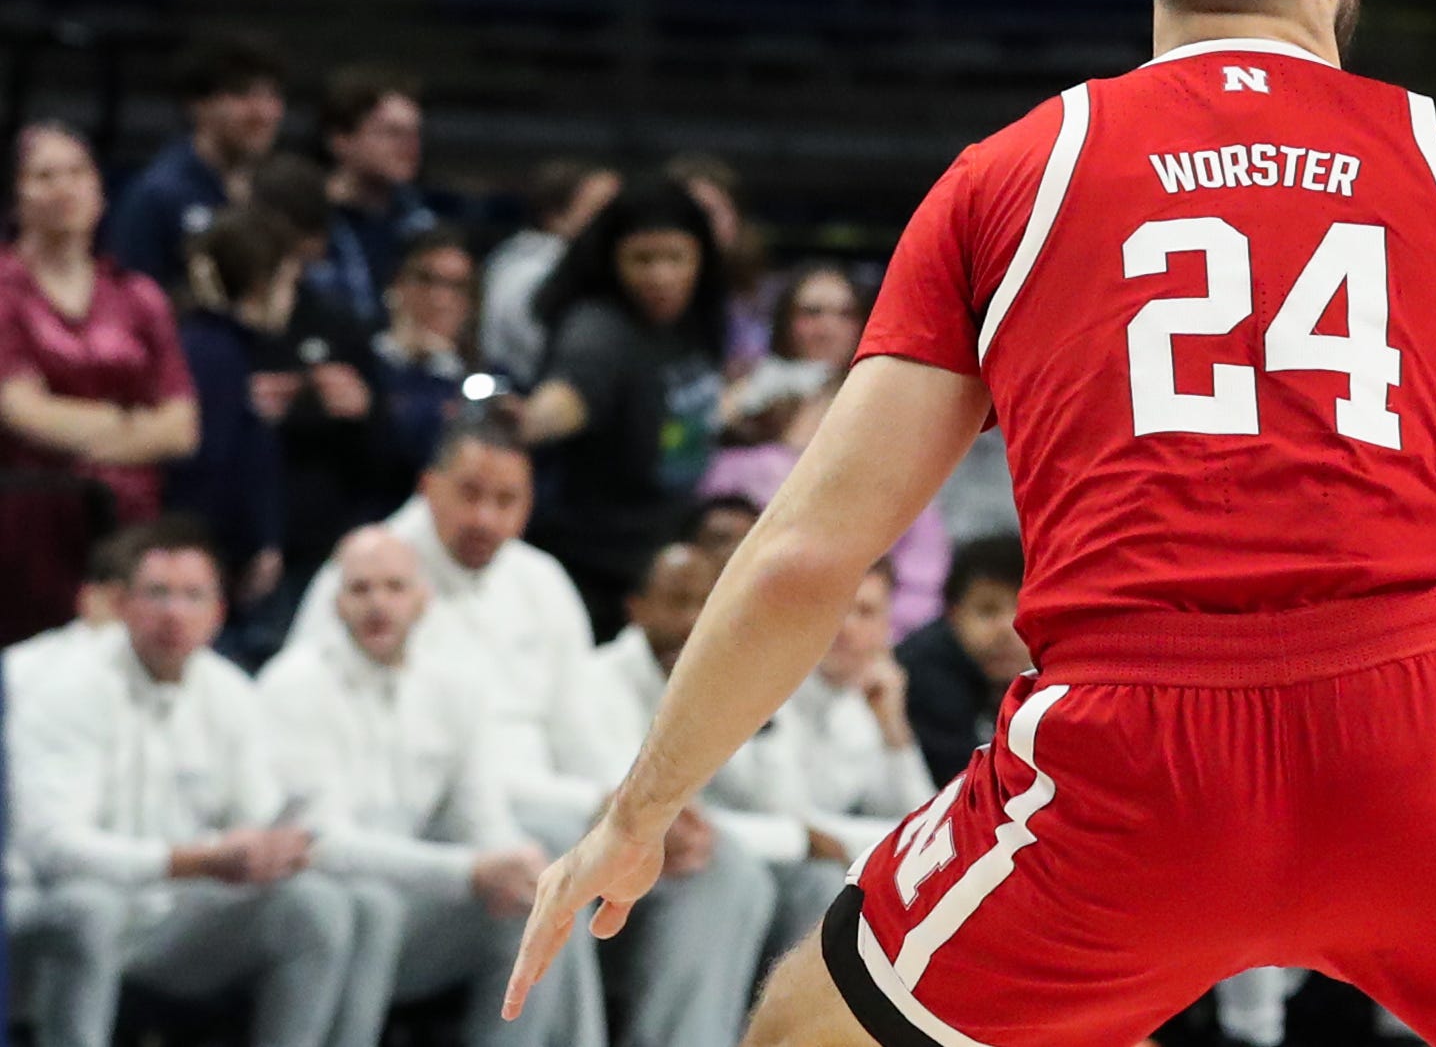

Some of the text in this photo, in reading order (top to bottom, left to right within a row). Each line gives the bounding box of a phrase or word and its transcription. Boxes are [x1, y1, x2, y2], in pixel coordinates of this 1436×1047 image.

[1222, 65, 1270, 94] N
[1149, 143, 1361, 196] WORSTER
[1122, 217, 1402, 451] 24
